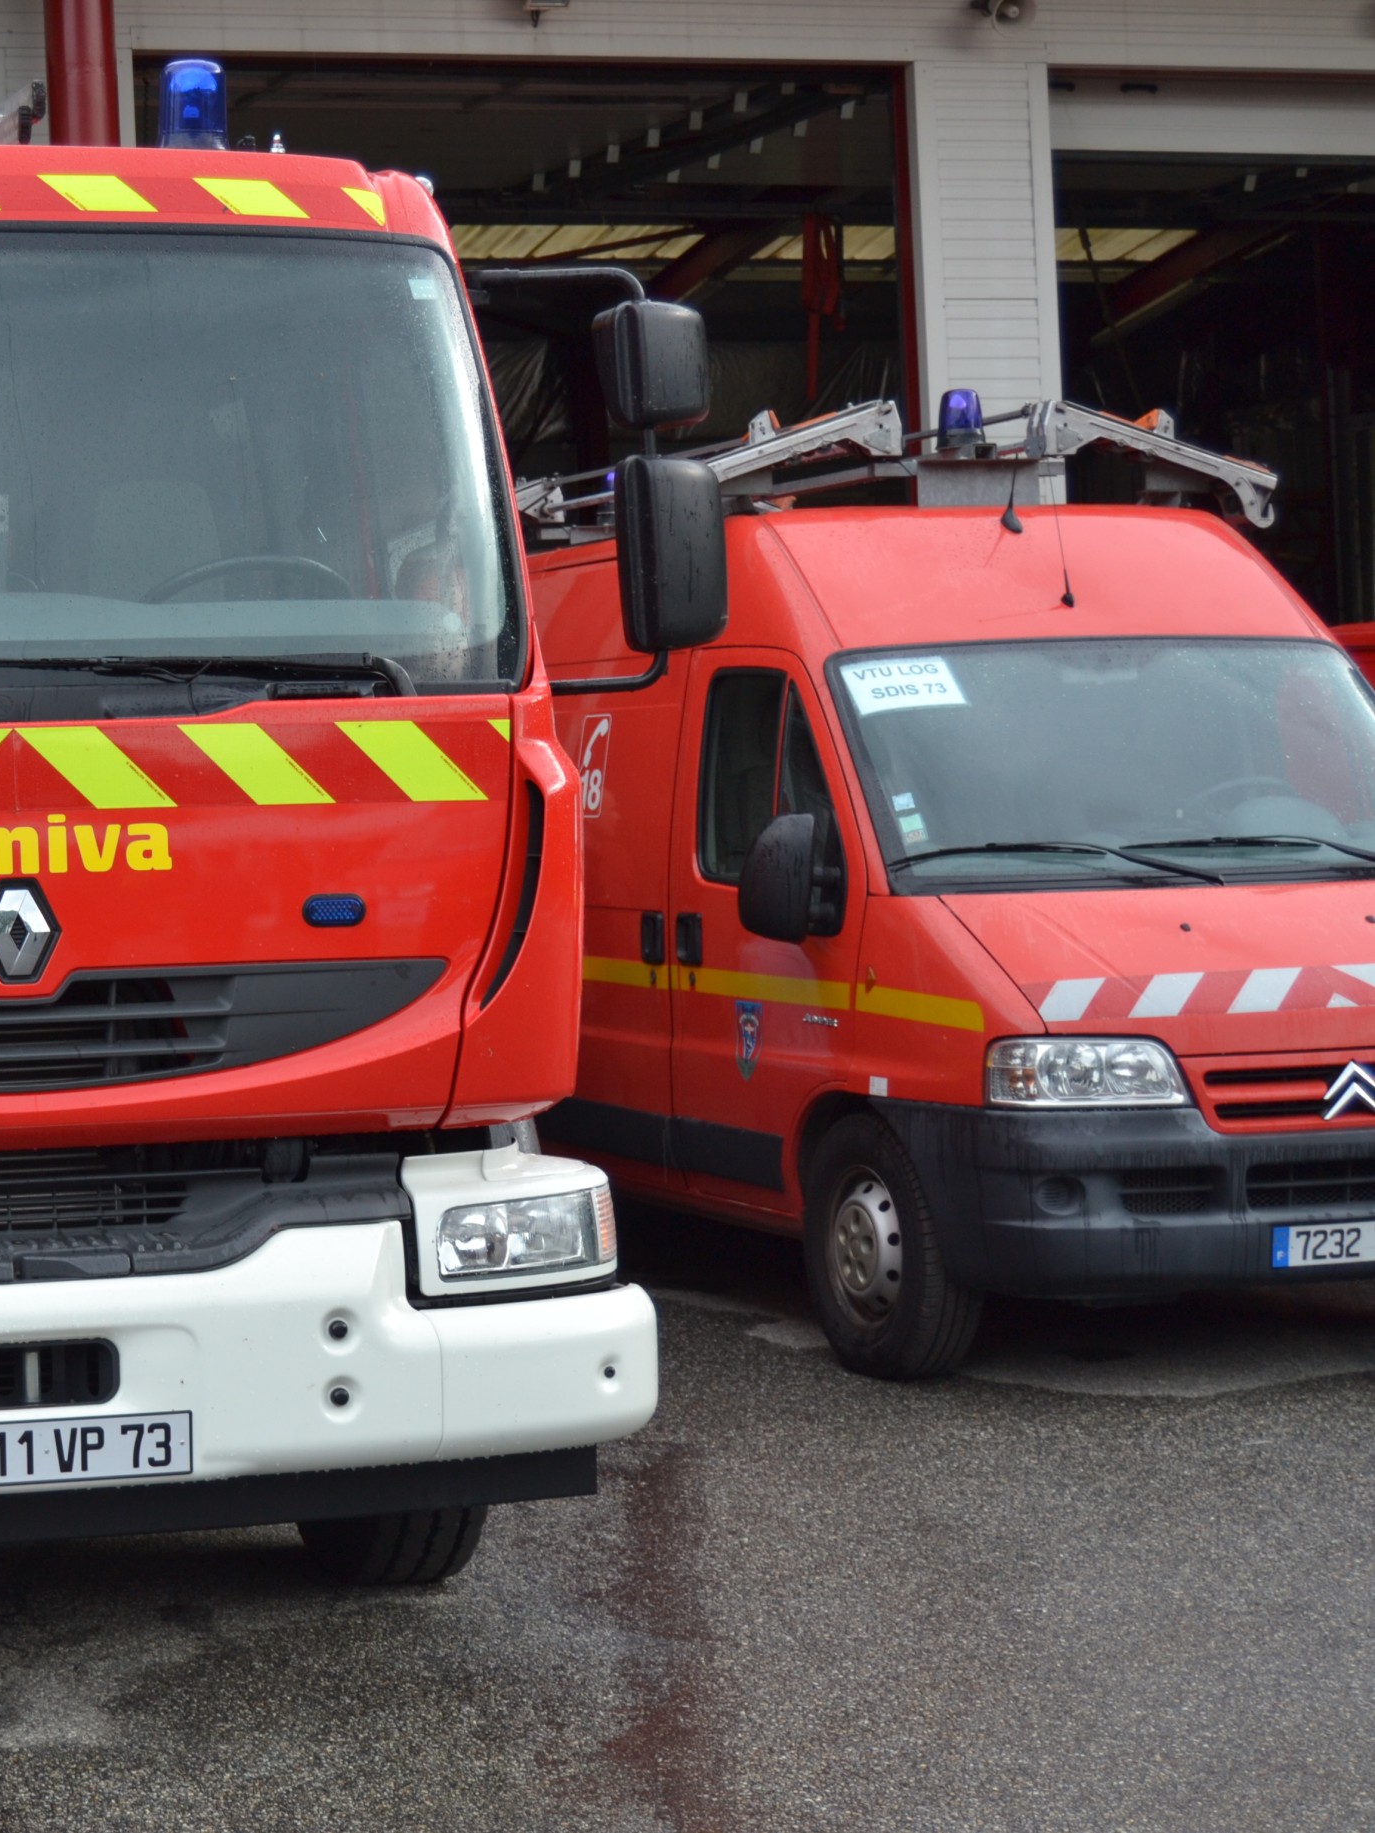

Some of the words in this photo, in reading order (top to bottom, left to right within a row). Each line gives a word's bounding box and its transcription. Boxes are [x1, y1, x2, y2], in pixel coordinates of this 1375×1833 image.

[853, 667, 892, 680] VTU
[897, 664, 939, 676] LOG
[871, 684, 919, 699] SDIS
[923, 682, 947, 694] 73
[581, 769, 602, 810] 18
[1295, 1228, 1361, 1260] 7232
[53, 1426, 105, 1473] VP
[120, 1422, 172, 1469] 73
